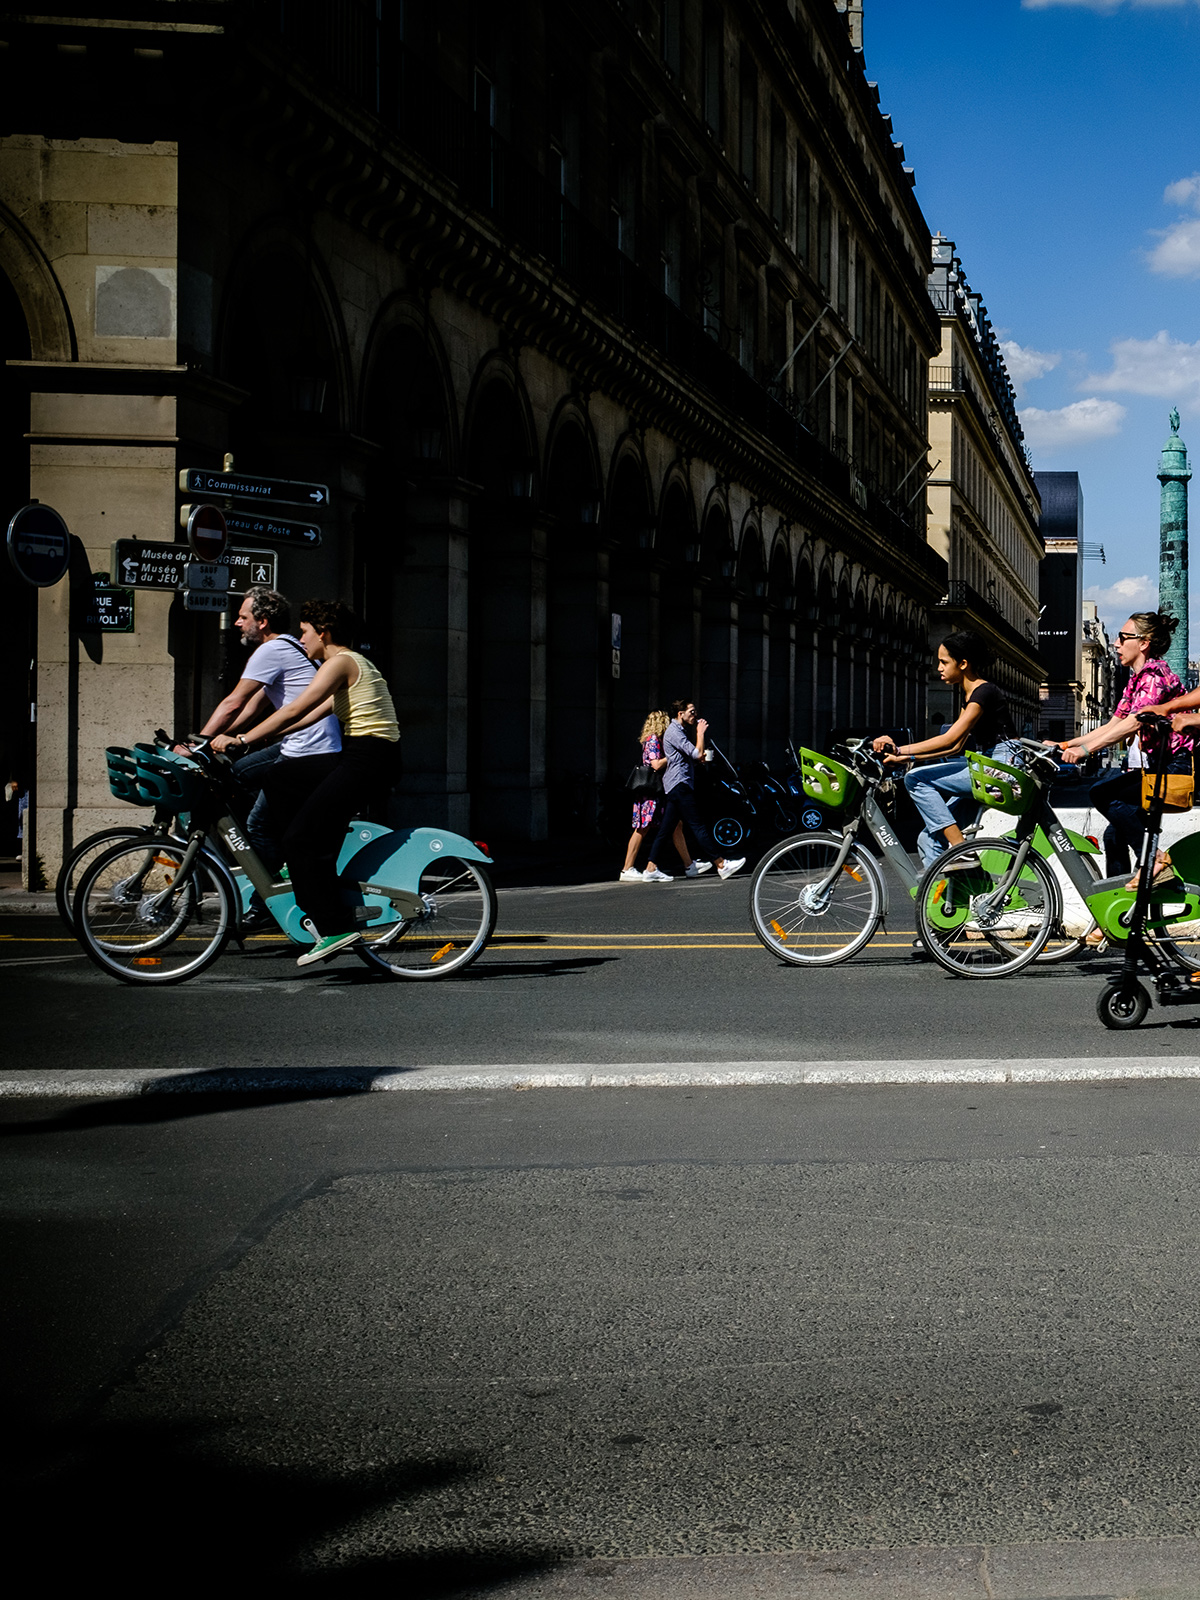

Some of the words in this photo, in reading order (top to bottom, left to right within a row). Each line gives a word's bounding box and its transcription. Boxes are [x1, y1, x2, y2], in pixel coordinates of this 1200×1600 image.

[207, 478, 272, 495] Commissariat
[226, 519, 251, 530] ureau
[254, 522, 264, 532] de
[267, 523, 292, 536] Poste
[141, 549, 173, 560] Musée
[175, 552, 187, 561] de
[141, 563, 177, 574] Musée
[200, 566, 218, 574] SAUF
[140, 572, 153, 582] du
[157, 573, 179, 584] JEU
[92, 597, 112, 606] RUE
[189, 596, 210, 606] SAUF
[212, 597, 228, 607] BUS
[87, 615, 118, 624] RIVOLI
